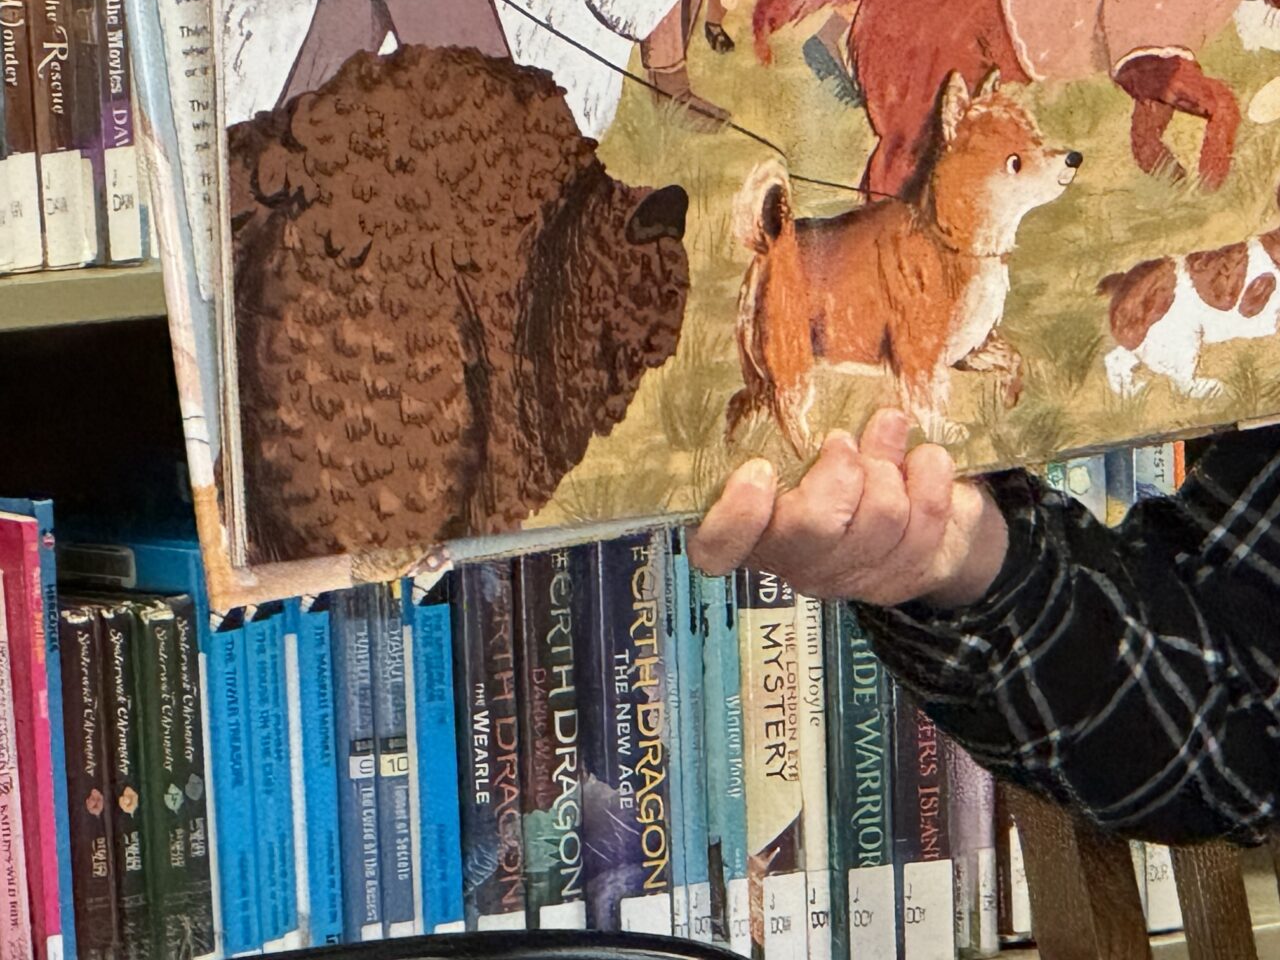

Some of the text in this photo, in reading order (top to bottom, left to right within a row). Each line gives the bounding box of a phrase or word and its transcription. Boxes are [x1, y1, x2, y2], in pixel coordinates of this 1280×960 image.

[37, 24, 69, 115] Rescue
[614, 648, 630, 694] THE
[759, 622, 789, 781] MYSTERY
[786, 659, 800, 742] LONDON
[805, 598, 826, 728] Brian Doyle
[387, 758, 409, 773] 10
[472, 709, 491, 805] WEARLE
[551, 709, 583, 897] DRAGON
[617, 764, 634, 810] AGE
[635, 703, 668, 890] DRAGON
[850, 710, 886, 867] WARRIOR
